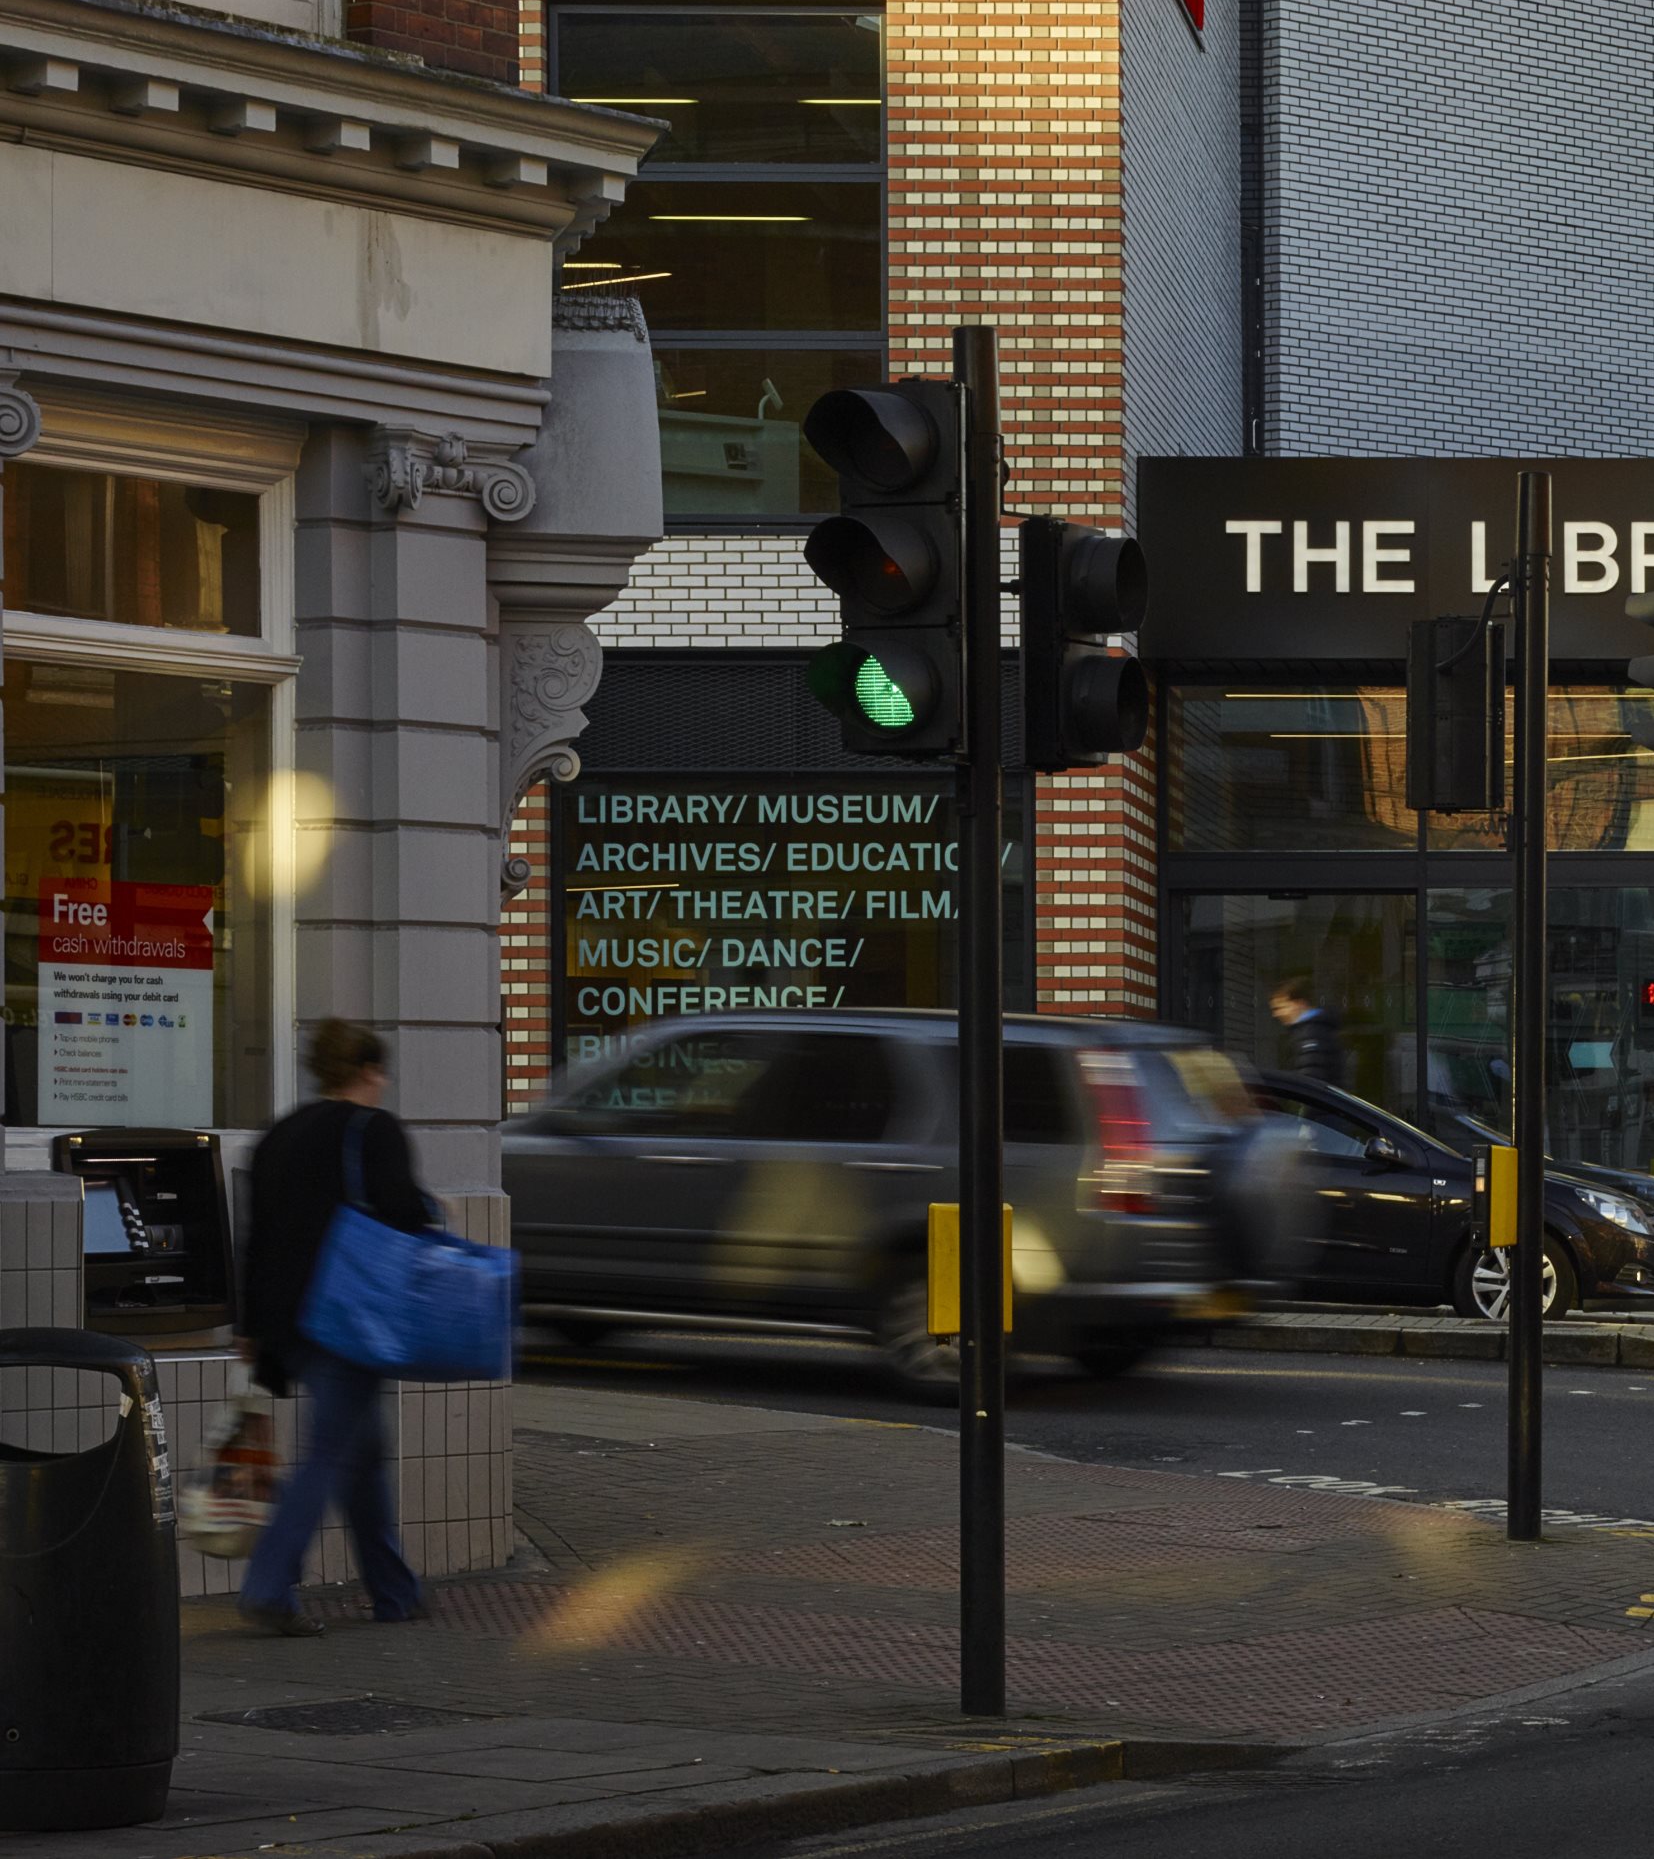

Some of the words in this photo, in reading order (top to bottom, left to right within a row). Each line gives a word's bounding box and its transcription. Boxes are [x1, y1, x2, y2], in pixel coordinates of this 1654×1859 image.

[1225, 520, 1416, 593] THE
[577, 795, 748, 824] LIBRARY/
[757, 795, 940, 824] MUSEUM/
[575, 842, 777, 872] ARCHIVES/
[53, 893, 108, 926] Free
[575, 890, 662, 920] ART/
[670, 890, 857, 920] THEATRE/
[53, 933, 88, 954] cash
[93, 934, 186, 958] withdrawals
[577, 938, 711, 968] MUSIC/
[721, 938, 865, 968] DANCE/
[53, 971, 66, 981] We
[68, 972, 90, 982] won't
[91, 973, 116, 984] charge
[118, 976, 132, 985] you
[134, 974, 144, 984] for
[146, 975, 163, 985] cash
[53, 988, 100, 999] withdrawals
[102, 991, 122, 1002] using
[124, 993, 141, 1003] your
[142, 991, 161, 1002] debit
[163, 993, 179, 1002] card
[59, 1048, 76, 1056] Check
[59, 1077, 72, 1086] Print
[59, 1093, 70, 1102] Pay
[70, 1092, 88, 1101] HSBC
[88, 1093, 104, 1102] credit
[105, 1093, 117, 1102] card
[118, 1094, 128, 1102] bills
[1217, 1469, 1419, 1495] LOOK
